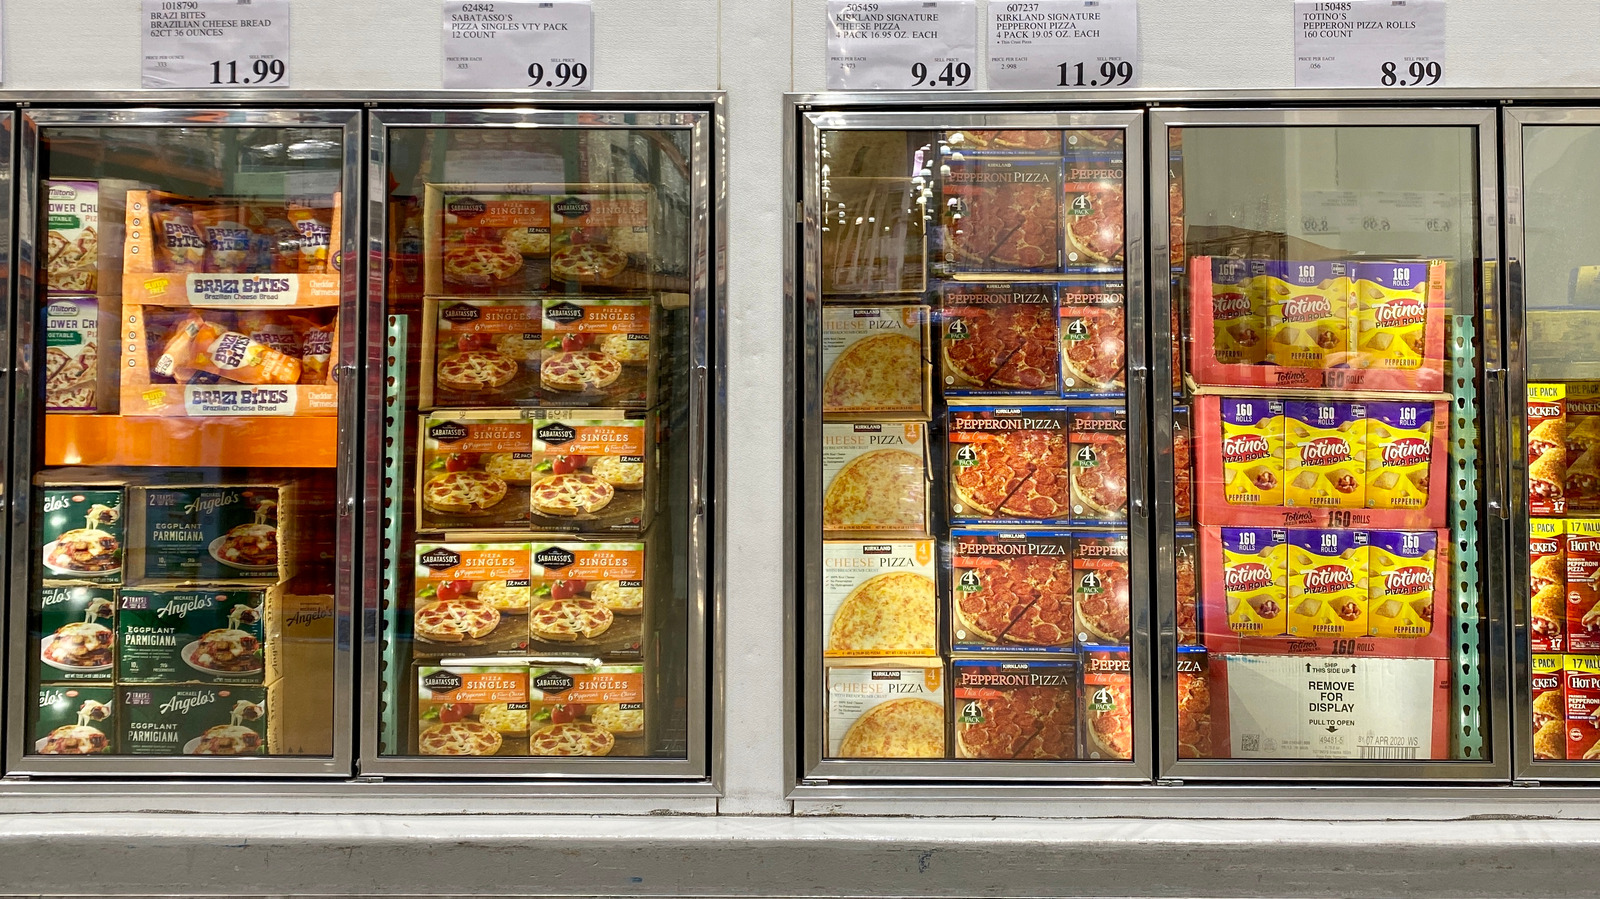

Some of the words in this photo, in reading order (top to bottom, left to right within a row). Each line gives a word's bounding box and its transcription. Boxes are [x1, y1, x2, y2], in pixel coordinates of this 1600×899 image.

[462, 4, 494, 12] 624842
[1007, 4, 1039, 12] 607237
[1315, 3, 1351, 11] 1150485
[210, 60, 285, 84] 11.99
[528, 63, 587, 87] 9.99
[911, 62, 971, 86] 9.49
[1057, 62, 1133, 86] 11.99
[1381, 61, 1441, 86] 8.99
[949, 173, 1012, 183] PEPPERONI
[1014, 172, 1049, 182] PIZZA
[1392, 268, 1410, 281] 160
[194, 279, 239, 293] BRAZI
[243, 276, 289, 292] BITES
[947, 293, 1012, 304] PEPPERONI
[1013, 293, 1049, 304] PIZZA
[589, 312, 636, 321] SINGLES
[192, 392, 237, 405] BRAZI
[241, 388, 288, 404] BITES
[1540, 388, 1558, 396] PACK
[1236, 404, 1252, 416] 160
[956, 418, 1021, 429] PEPPERONI
[1023, 418, 1060, 429] PIZZA
[581, 434, 629, 442] SINGLES
[1297, 436, 1351, 459] Totino's
[1300, 459, 1324, 467] PIZZA
[1327, 455, 1352, 464] ROLLS
[184, 491, 239, 515] Angelo's
[1554, 502, 1565, 510] 17
[1328, 511, 1350, 528] 160
[1353, 515, 1370, 524] ROLLS
[1537, 524, 1555, 532] PACK
[1572, 522, 1580, 531] 17
[153, 530, 204, 542] PARMIGIANA
[1321, 534, 1337, 547] 160
[919, 544, 926, 554] 4
[959, 543, 1026, 554] PEPPERONI
[1028, 544, 1065, 555] PIZZA
[1571, 541, 1588, 551] HOT
[825, 558, 874, 567] CHEESE
[880, 558, 914, 567] PIZZA
[963, 570, 974, 584] 4
[1299, 566, 1354, 588] Totino's
[1304, 586, 1328, 594] PIZZA
[1330, 582, 1355, 591] ROLLS
[122, 597, 128, 608] 2
[157, 595, 212, 618] Angelo's
[125, 635, 176, 646] PARMIGIANA
[1551, 639, 1562, 648] 17
[928, 670, 935, 680] 4
[962, 674, 1030, 686] PEPPERONI
[1030, 674, 1068, 686] PIZZA
[834, 683, 883, 693] CHEESE
[888, 684, 923, 693] PIZZA
[1309, 681, 1354, 690] REMOVE
[1572, 678, 1591, 688] HOT
[160, 690, 216, 715] Angelo's
[1320, 693, 1343, 701] FOR
[1309, 703, 1354, 712] DISPLAY
[128, 730, 179, 742] PARMIGIANA
[1376, 737, 1388, 745] APR
[1408, 738, 1418, 746] WS
